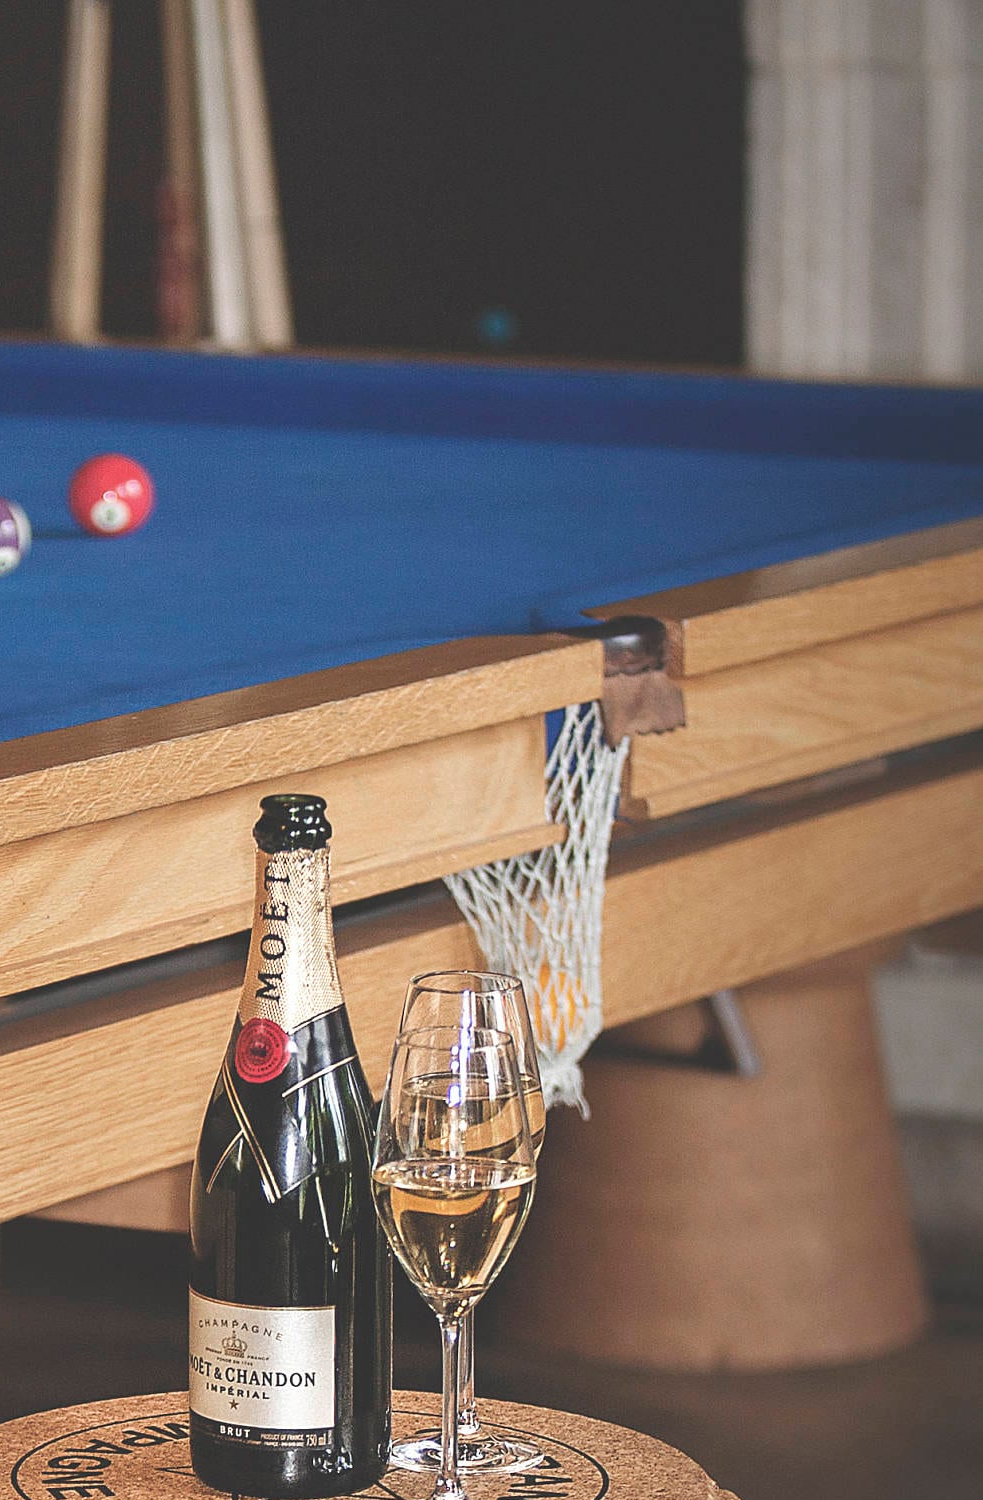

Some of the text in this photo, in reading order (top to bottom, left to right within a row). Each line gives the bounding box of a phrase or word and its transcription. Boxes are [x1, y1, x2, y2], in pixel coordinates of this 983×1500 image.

[198, 1319, 284, 1342] CHAMPAGNE
[214, 1366, 223, 1381] &
[225, 1367, 317, 1388] CHANDON
[206, 1382, 270, 1400] IMPÉRIAL
[219, 1425, 251, 1438] BRUT
[305, 1433, 318, 1447] 750
[41, 1421, 190, 1500] MPAGNE
